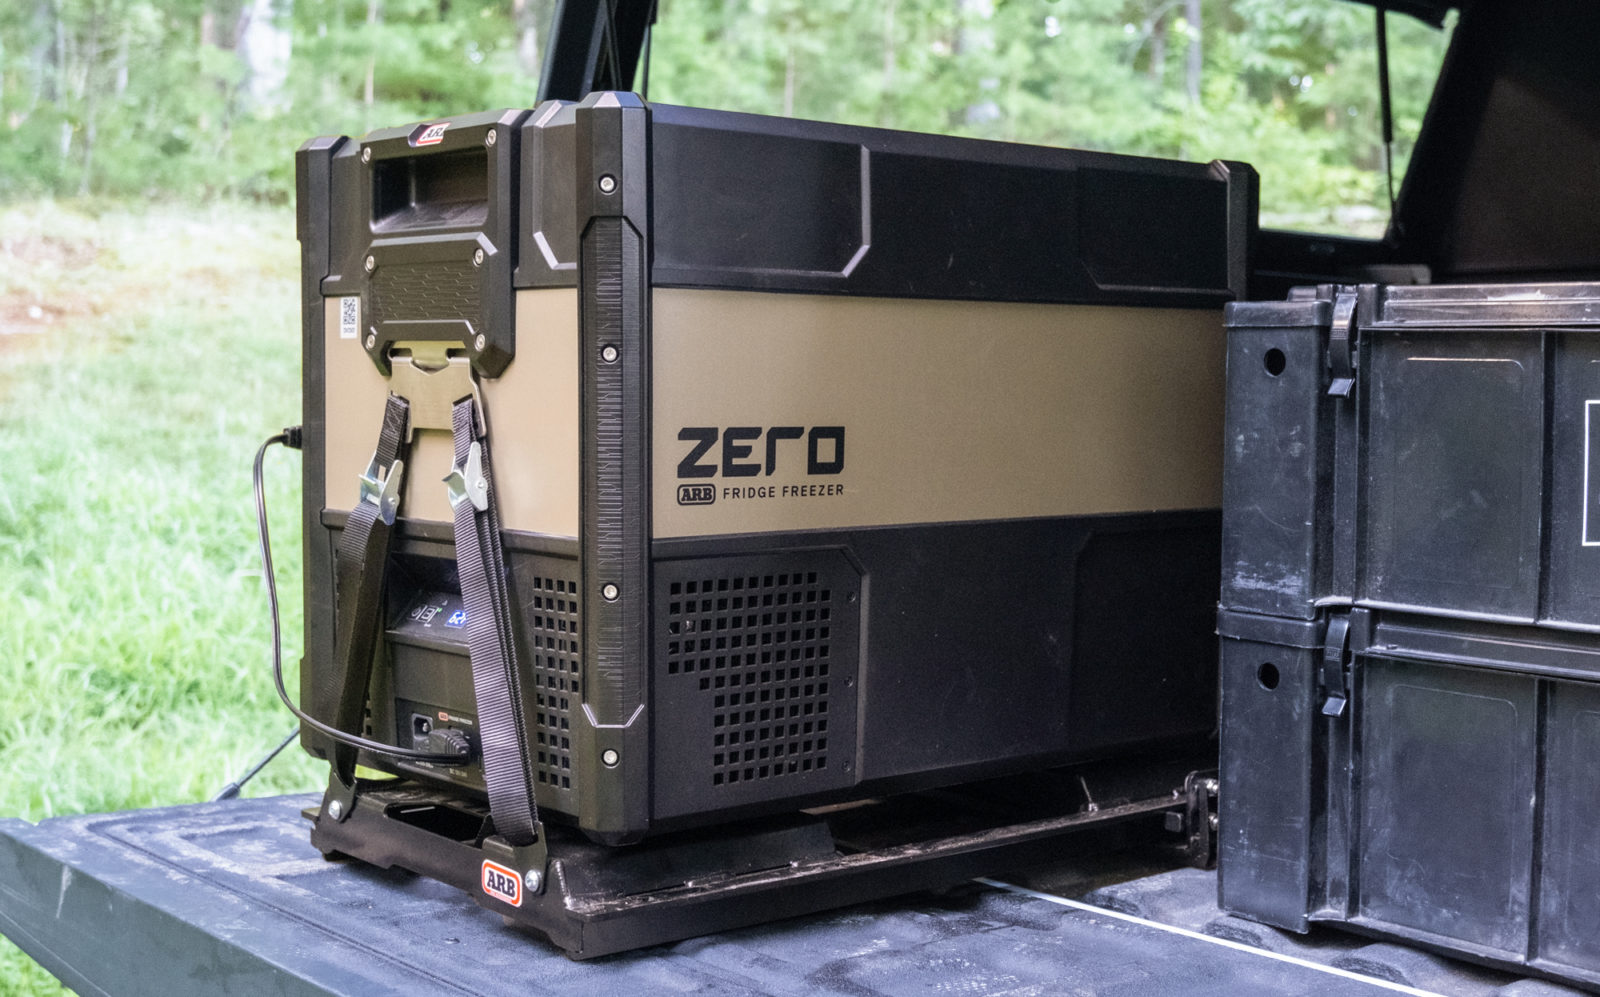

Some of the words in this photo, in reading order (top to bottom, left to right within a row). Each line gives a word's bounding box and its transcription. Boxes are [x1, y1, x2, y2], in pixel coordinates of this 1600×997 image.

[421, 127, 444, 140] AR
[681, 487, 713, 502] ARB
[723, 486, 776, 500] FRIDGE
[782, 484, 844, 498] FREEZER
[487, 870, 516, 898] ARB
